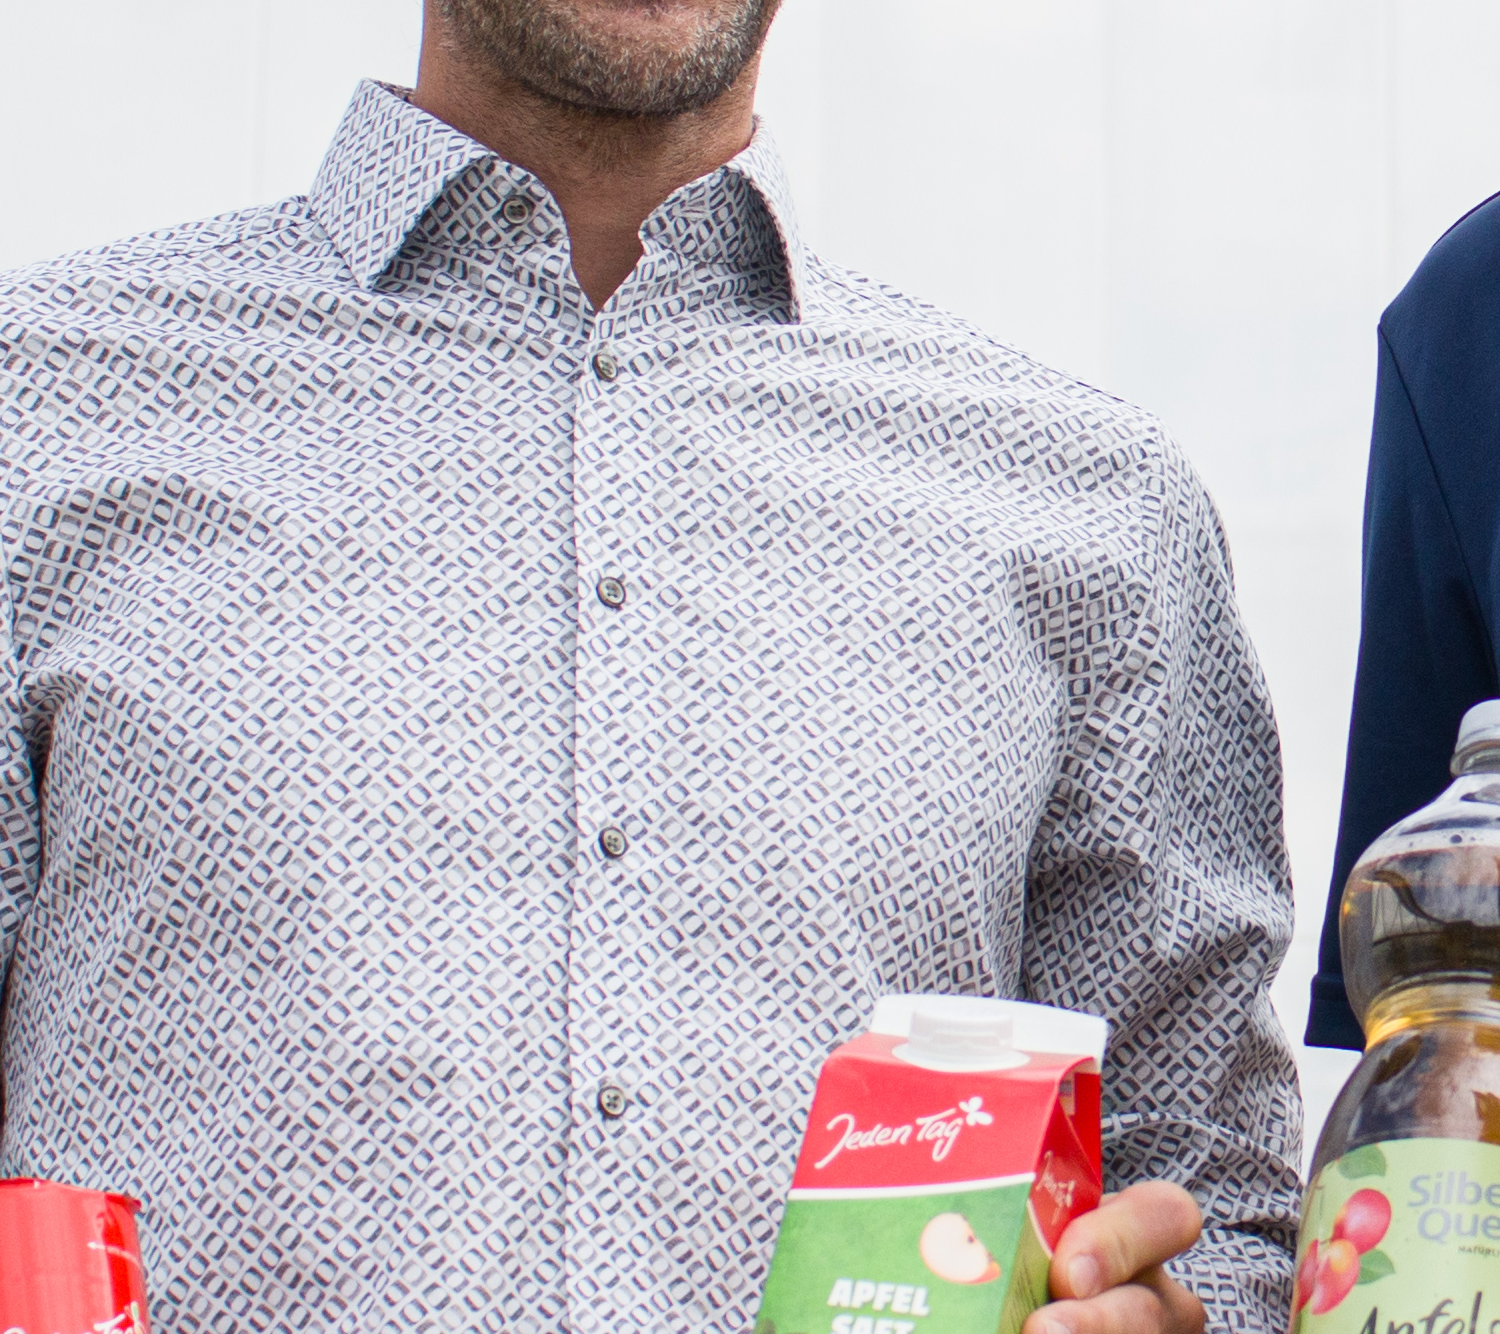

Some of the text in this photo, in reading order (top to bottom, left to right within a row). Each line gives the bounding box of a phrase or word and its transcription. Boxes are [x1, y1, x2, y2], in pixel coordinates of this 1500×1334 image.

[814, 1108, 964, 1170] Jeden Tag
[827, 1277, 931, 1317] APFEL
